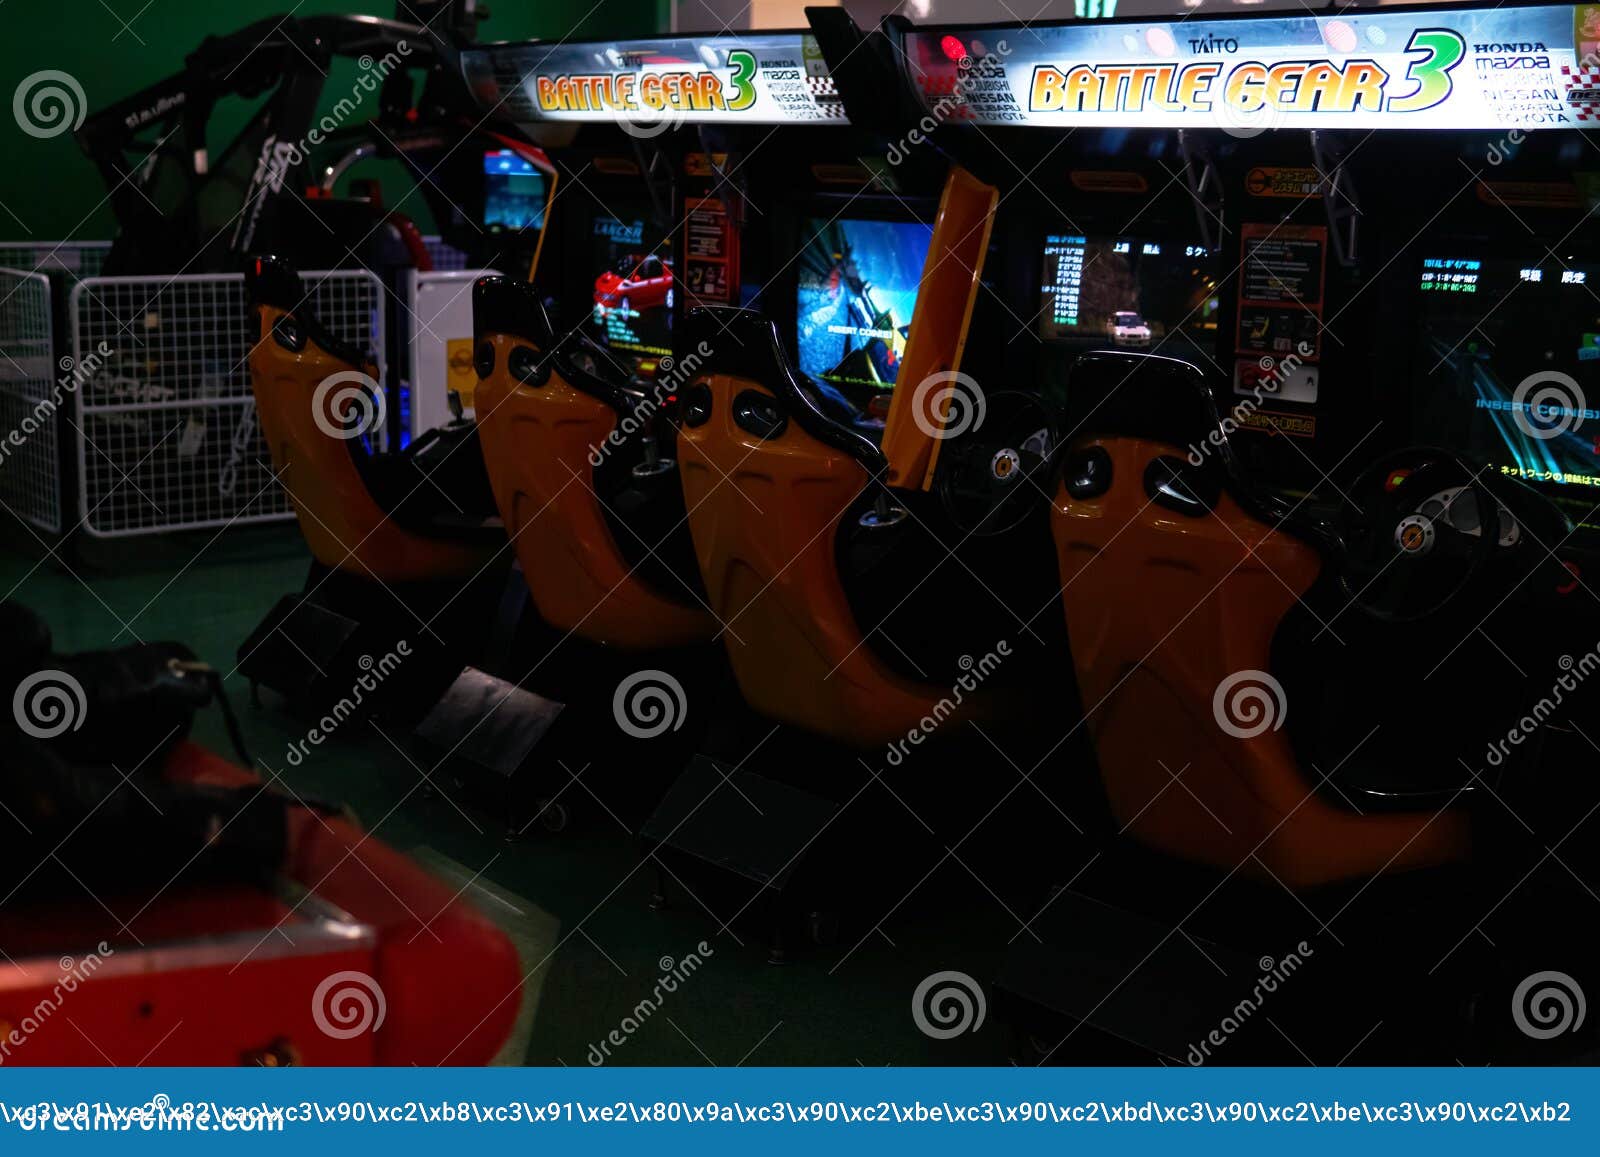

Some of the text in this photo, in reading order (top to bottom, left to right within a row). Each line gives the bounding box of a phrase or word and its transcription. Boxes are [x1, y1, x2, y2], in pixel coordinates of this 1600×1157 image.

[1188, 33, 1238, 54] TAITO
[1473, 42, 1549, 54] HONDA
[760, 60, 798, 68] HONDA
[1029, 62, 1224, 112] BATTLE
[1225, 59, 1389, 112] GEAR
[1387, 27, 1466, 112] 3
[536, 72, 635, 112] BATTLE
[639, 72, 727, 112] GEAR
[725, 50, 757, 112] 3
[966, 93, 1016, 103] NISSAN
[979, 112, 1028, 121] TOYOTA
[1475, 399, 1532, 413] INSERT
